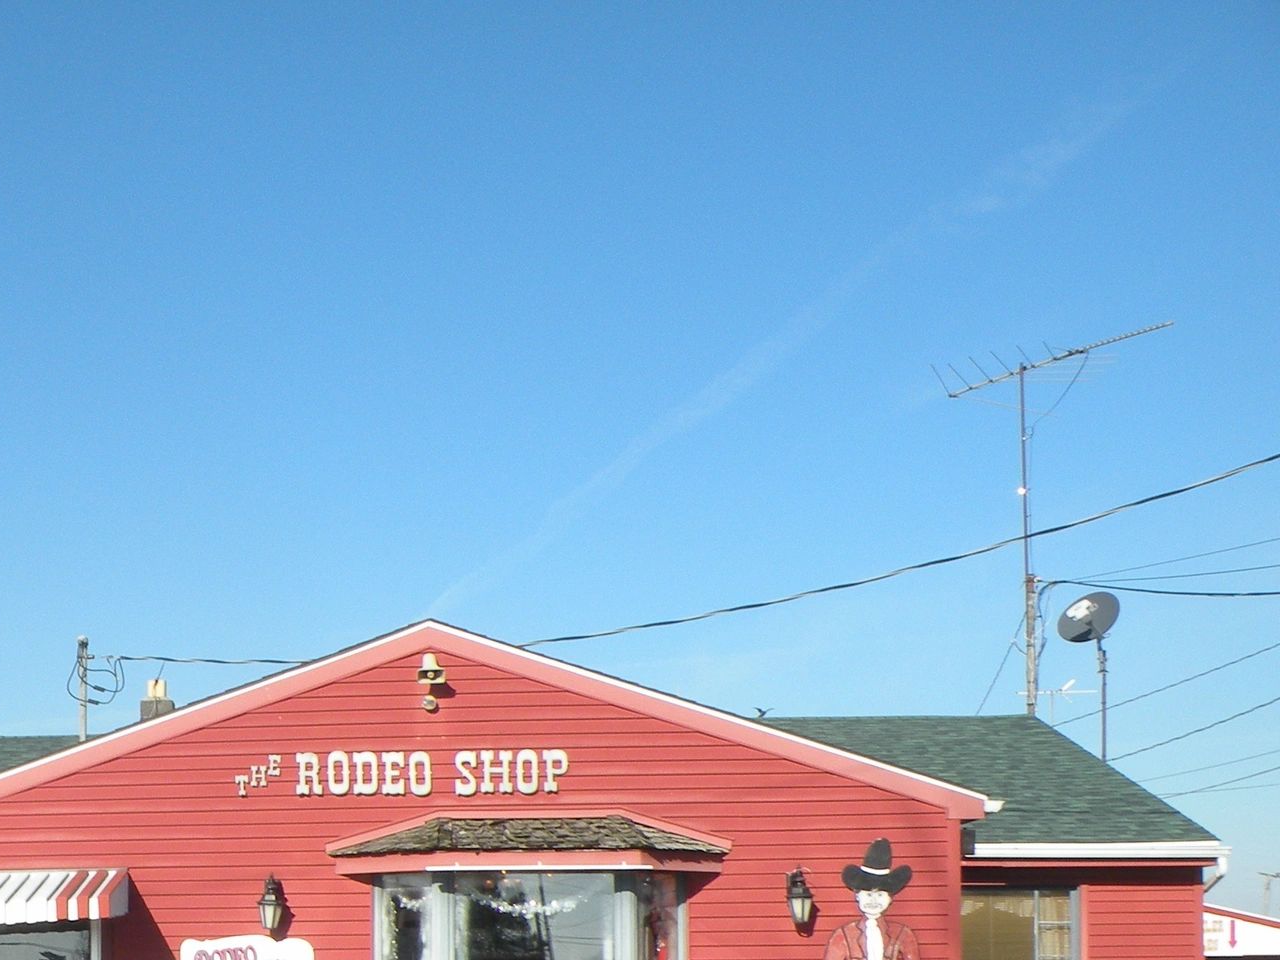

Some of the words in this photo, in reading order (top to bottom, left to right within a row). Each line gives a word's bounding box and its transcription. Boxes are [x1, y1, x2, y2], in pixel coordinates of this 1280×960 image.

[235, 754, 282, 797] THE
[295, 750, 433, 797] RODEO
[455, 748, 570, 796] SHOP
